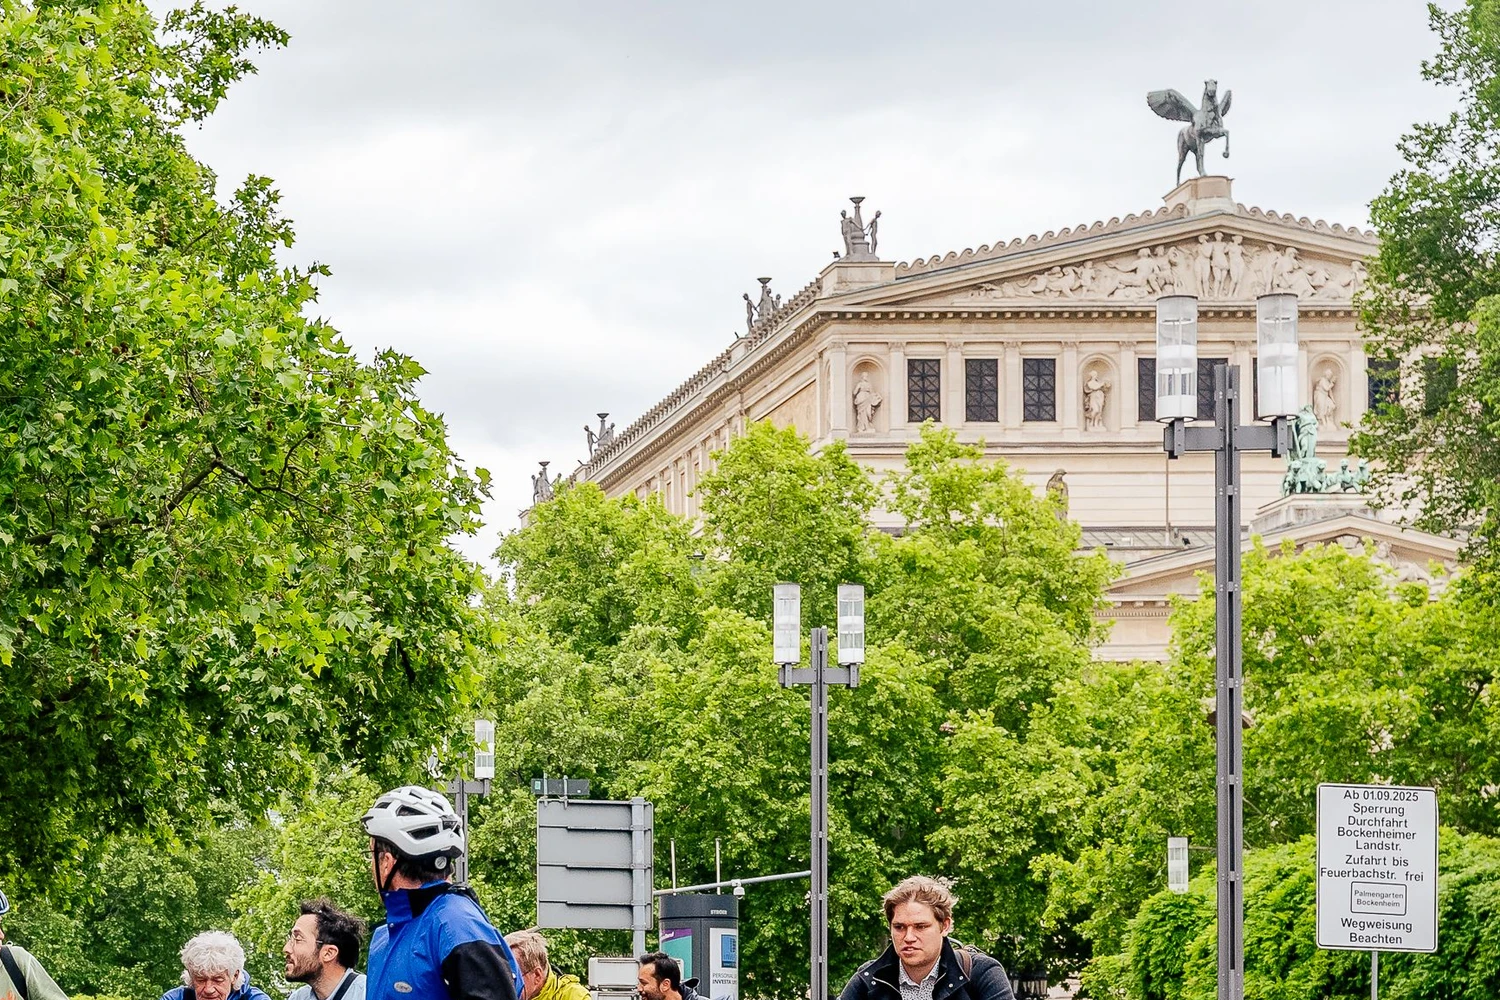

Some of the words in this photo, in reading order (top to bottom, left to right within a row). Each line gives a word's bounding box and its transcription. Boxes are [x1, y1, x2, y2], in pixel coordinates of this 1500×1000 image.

[1344, 790, 1359, 799] Ab
[1363, 791, 1418, 802] 01.09.2025
[1353, 803, 1405, 817] Sperrung
[1348, 816, 1408, 828] Durchfahrt
[1337, 827, 1417, 839] Bockenheimer
[1356, 840, 1402, 851] Landstr.
[1345, 855, 1387, 866] Zufahrt
[1392, 856, 1409, 866] bis
[1320, 868, 1397, 880] Feuerbachstr.
[1405, 871, 1424, 881] frei
[1354, 890, 1403, 899] Palmengarten
[1356, 899, 1400, 907] Bockenheim
[1341, 918, 1413, 933] Wegweisung
[1349, 932, 1403, 944] Beachten
